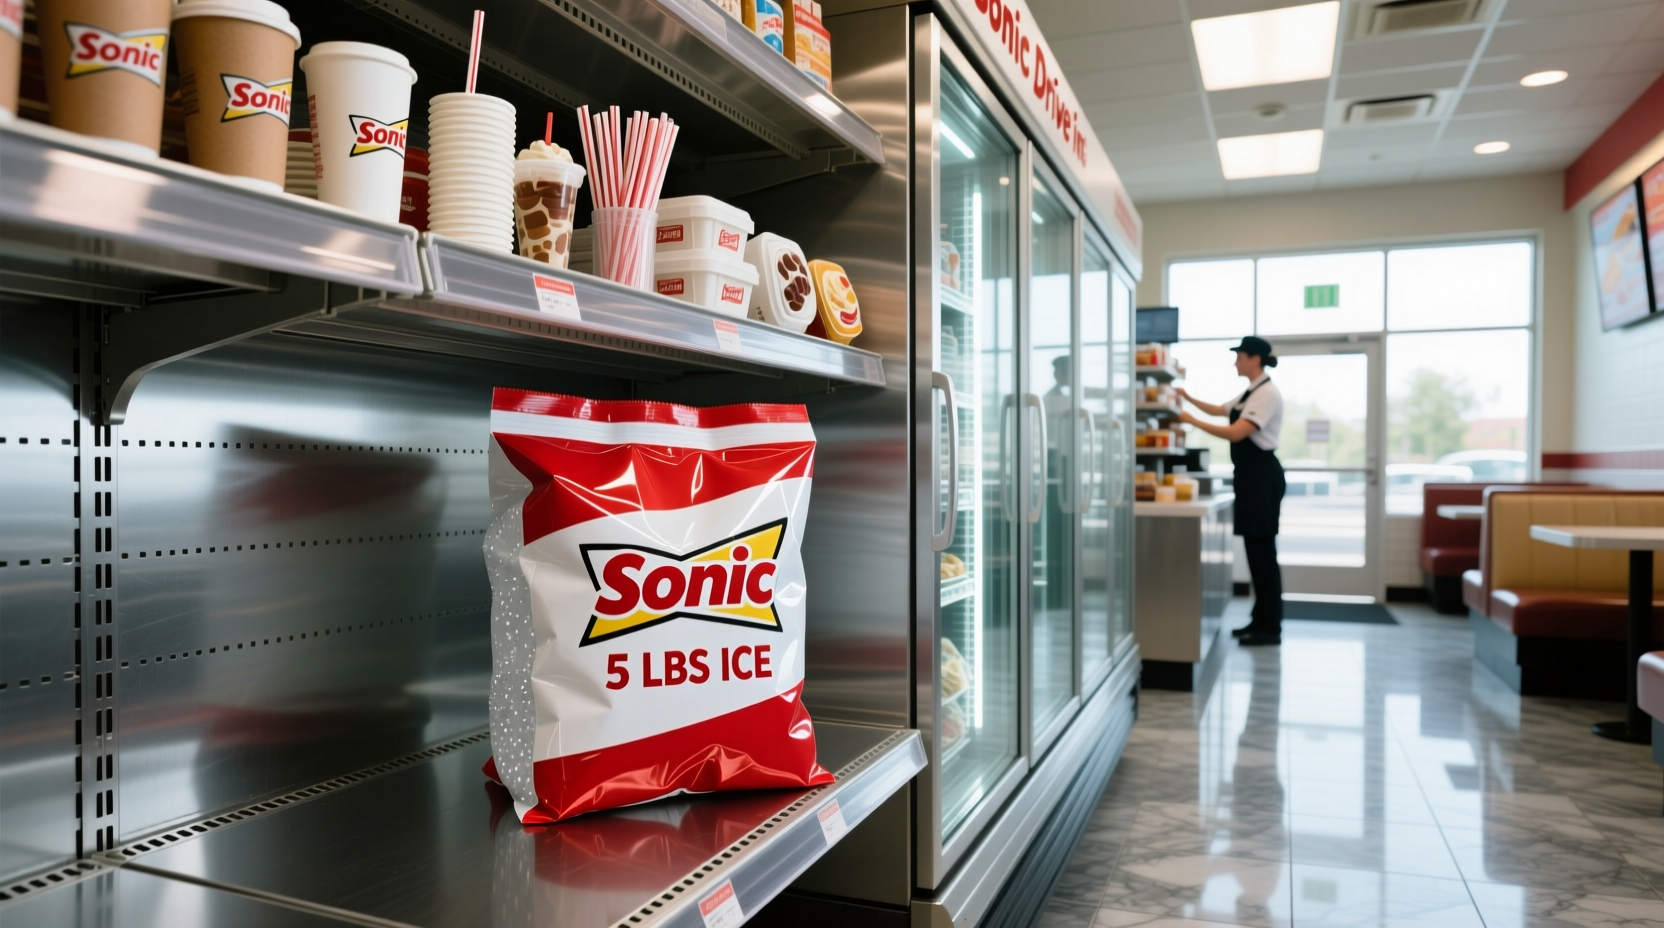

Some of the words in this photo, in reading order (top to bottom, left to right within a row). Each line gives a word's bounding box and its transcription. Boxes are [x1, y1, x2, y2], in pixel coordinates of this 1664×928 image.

[76, 32, 160, 71] Sonic
[1033, 43, 1071, 143] Drive
[594, 545, 777, 616] Sonic
[605, 652, 630, 691] 5
[642, 647, 710, 688] LBS
[721, 644, 773, 682] ICE
